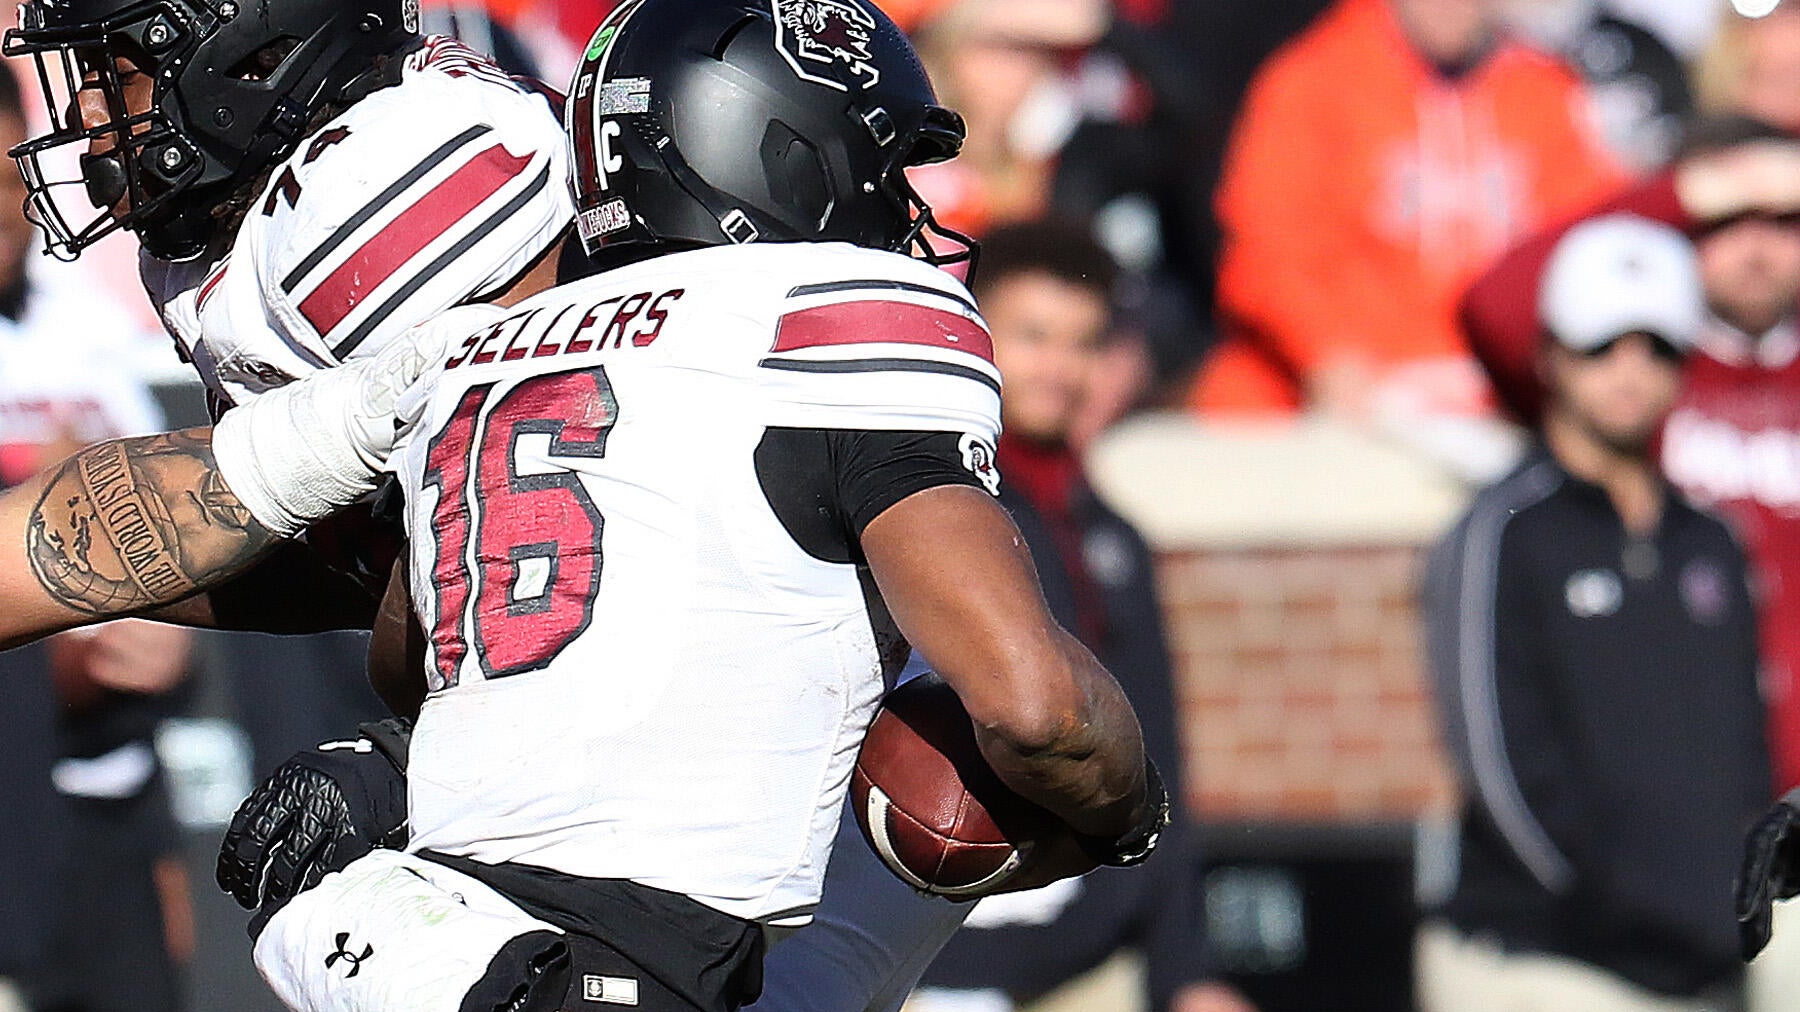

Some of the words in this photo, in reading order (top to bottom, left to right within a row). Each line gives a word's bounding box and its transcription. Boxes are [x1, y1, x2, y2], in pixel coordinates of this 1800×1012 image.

[601, 120, 623, 173] C
[444, 288, 686, 371] SELLERS
[99, 484, 134, 512] IS
[422, 364, 620, 692] 16
[108, 502, 162, 575] WORLD
[140, 561, 187, 599] THE
